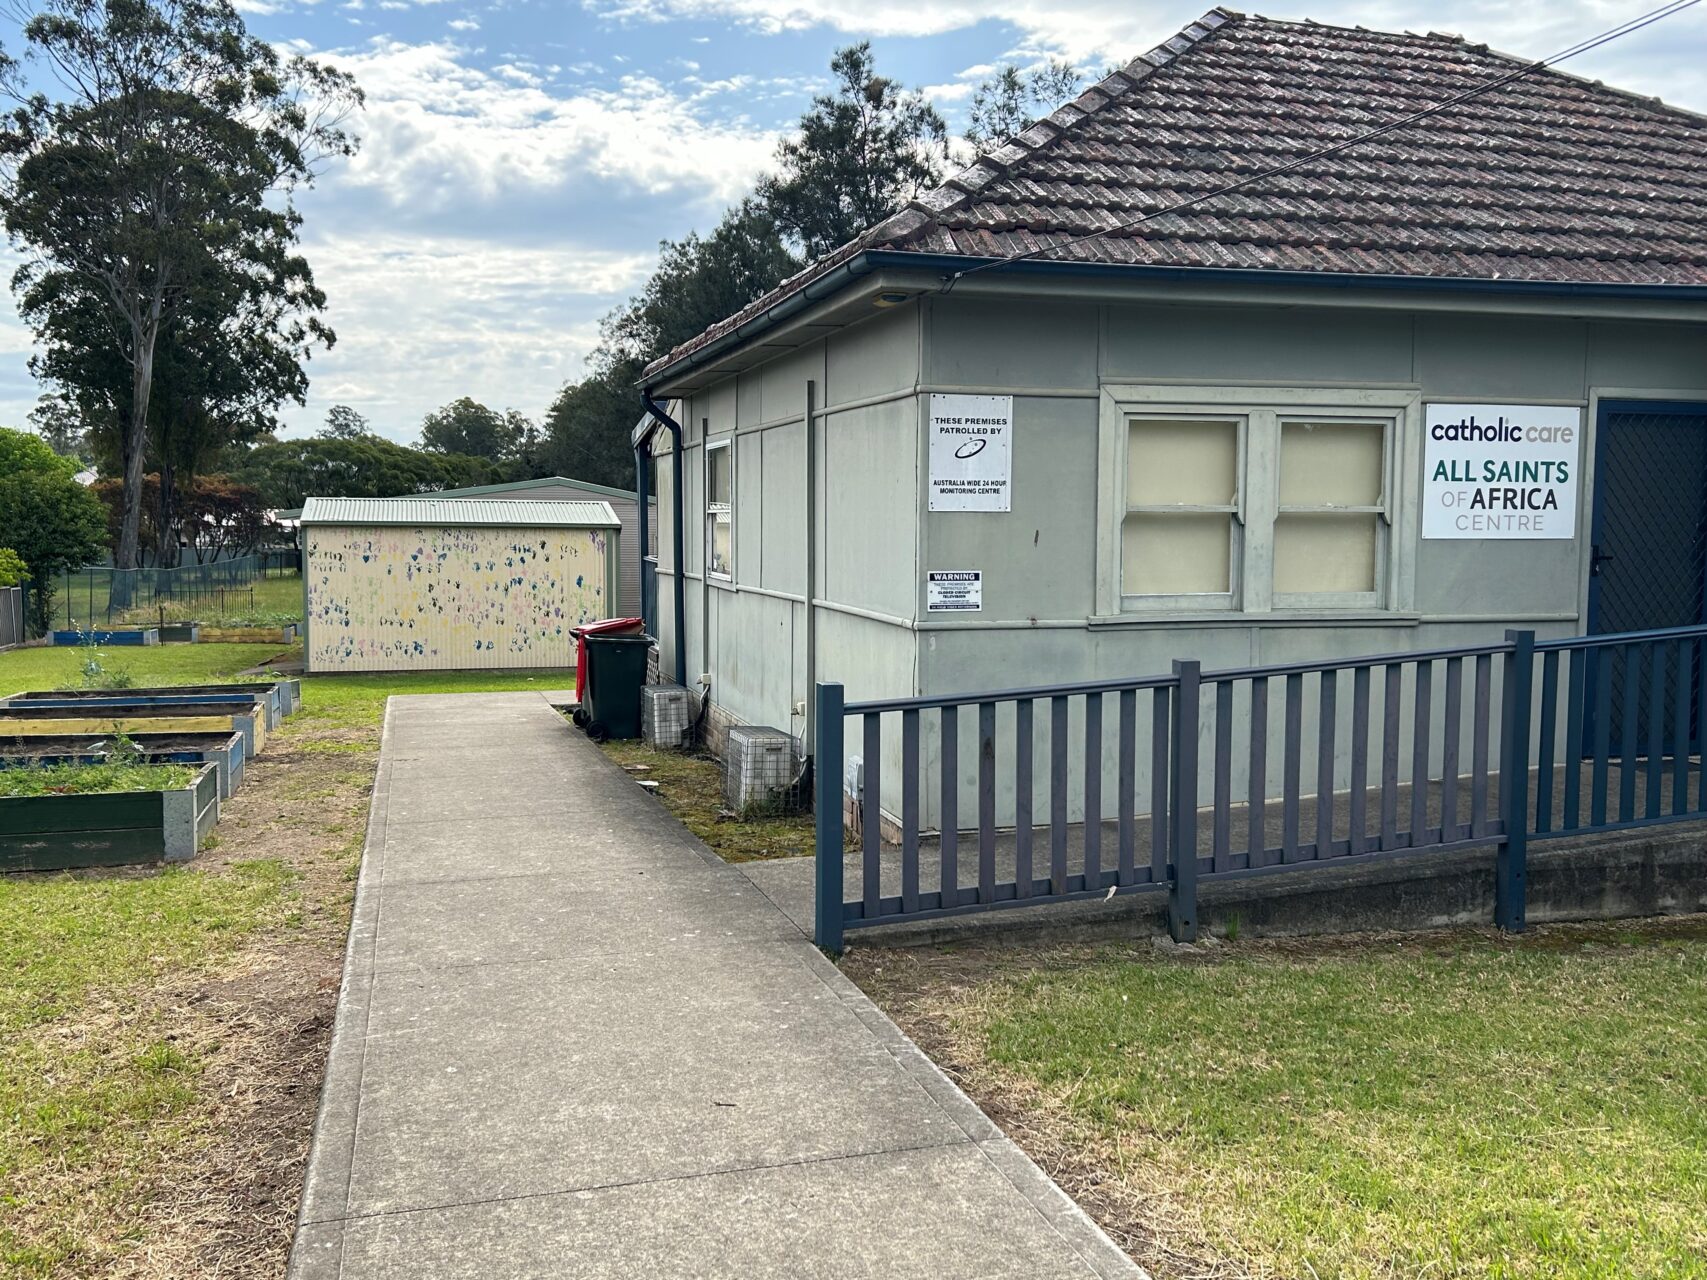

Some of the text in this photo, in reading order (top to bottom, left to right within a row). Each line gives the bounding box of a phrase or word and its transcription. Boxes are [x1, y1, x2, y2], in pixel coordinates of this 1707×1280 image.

[1431, 416, 1574, 443] catholic care
[1432, 460, 1569, 484] ALL SAINTS
[1441, 488, 1558, 510] OF AFRICA
[1456, 514, 1544, 531] CENTRE
